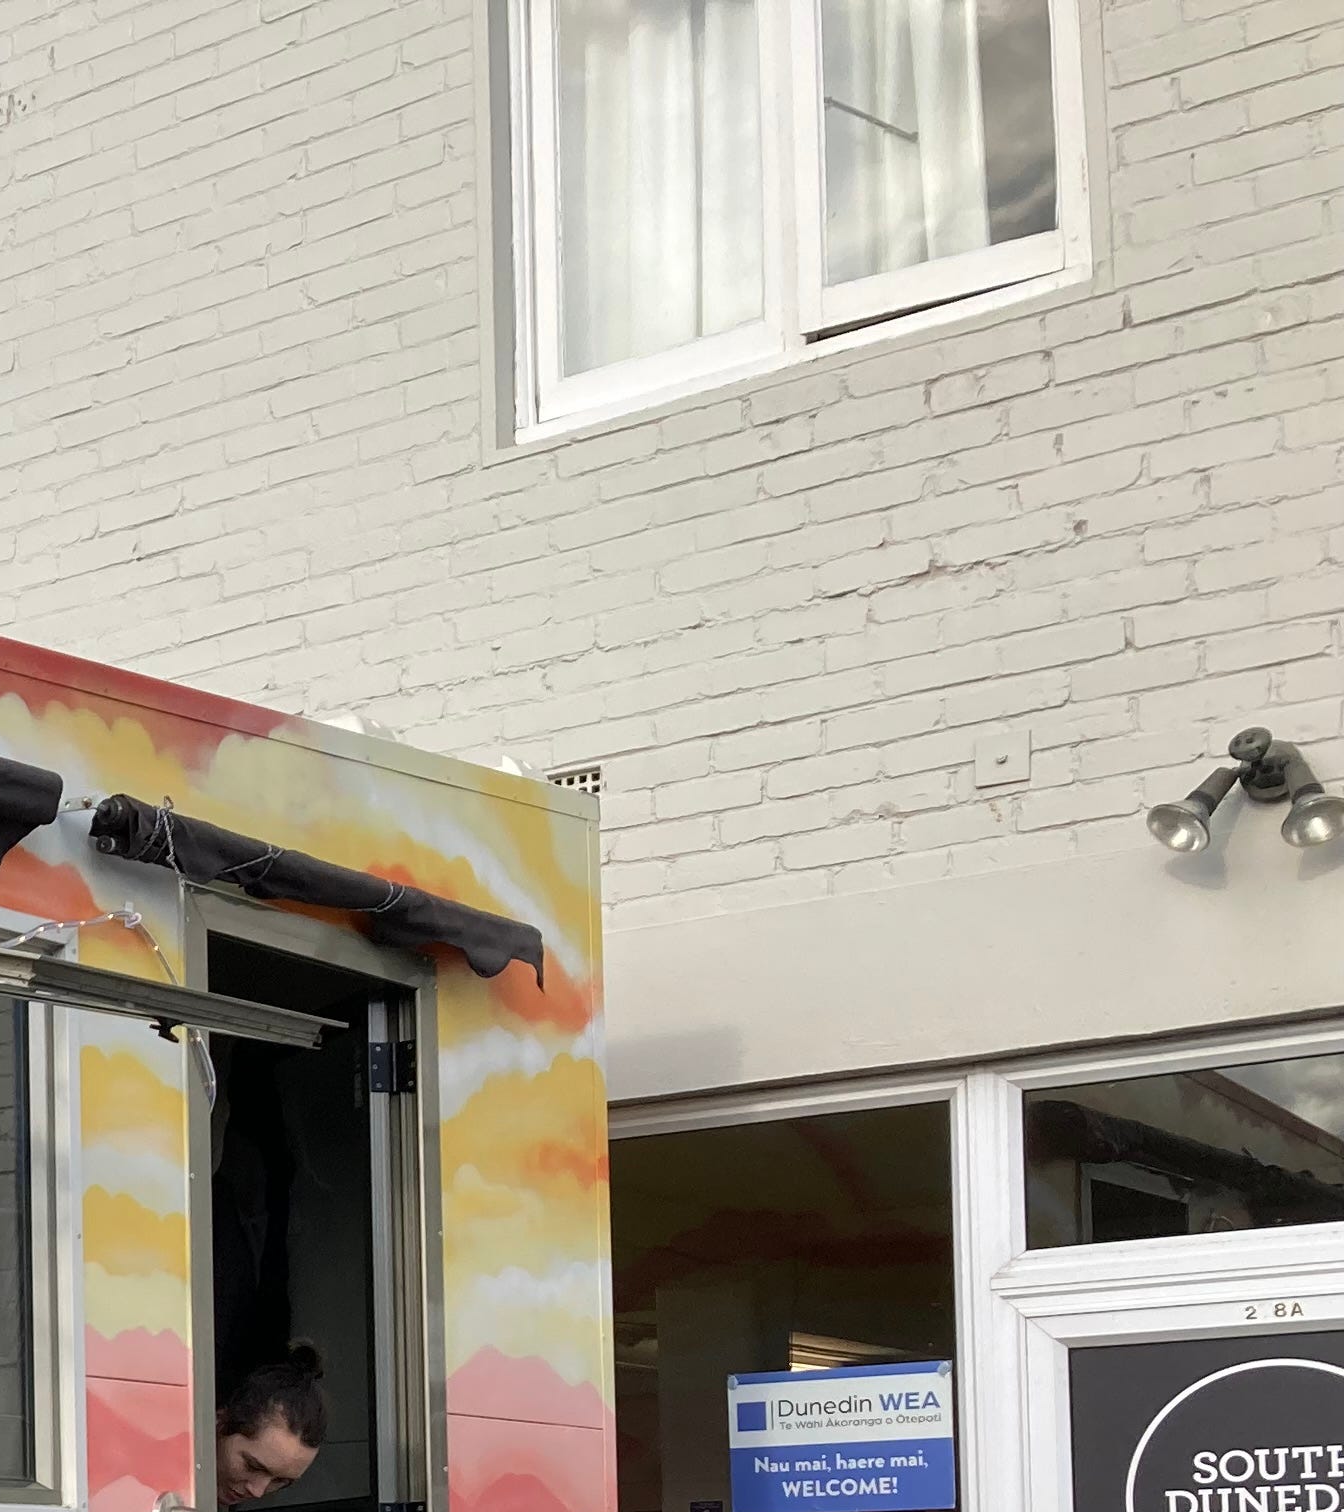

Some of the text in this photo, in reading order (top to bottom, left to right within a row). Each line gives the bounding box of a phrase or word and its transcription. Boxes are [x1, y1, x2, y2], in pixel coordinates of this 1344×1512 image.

[778, 1391, 941, 1418] Dunedin WEA
[779, 1421, 792, 1431] Te
[754, 1450, 928, 1474] Nau mai, haere mai,
[781, 1477, 898, 1498] WELCOME!
